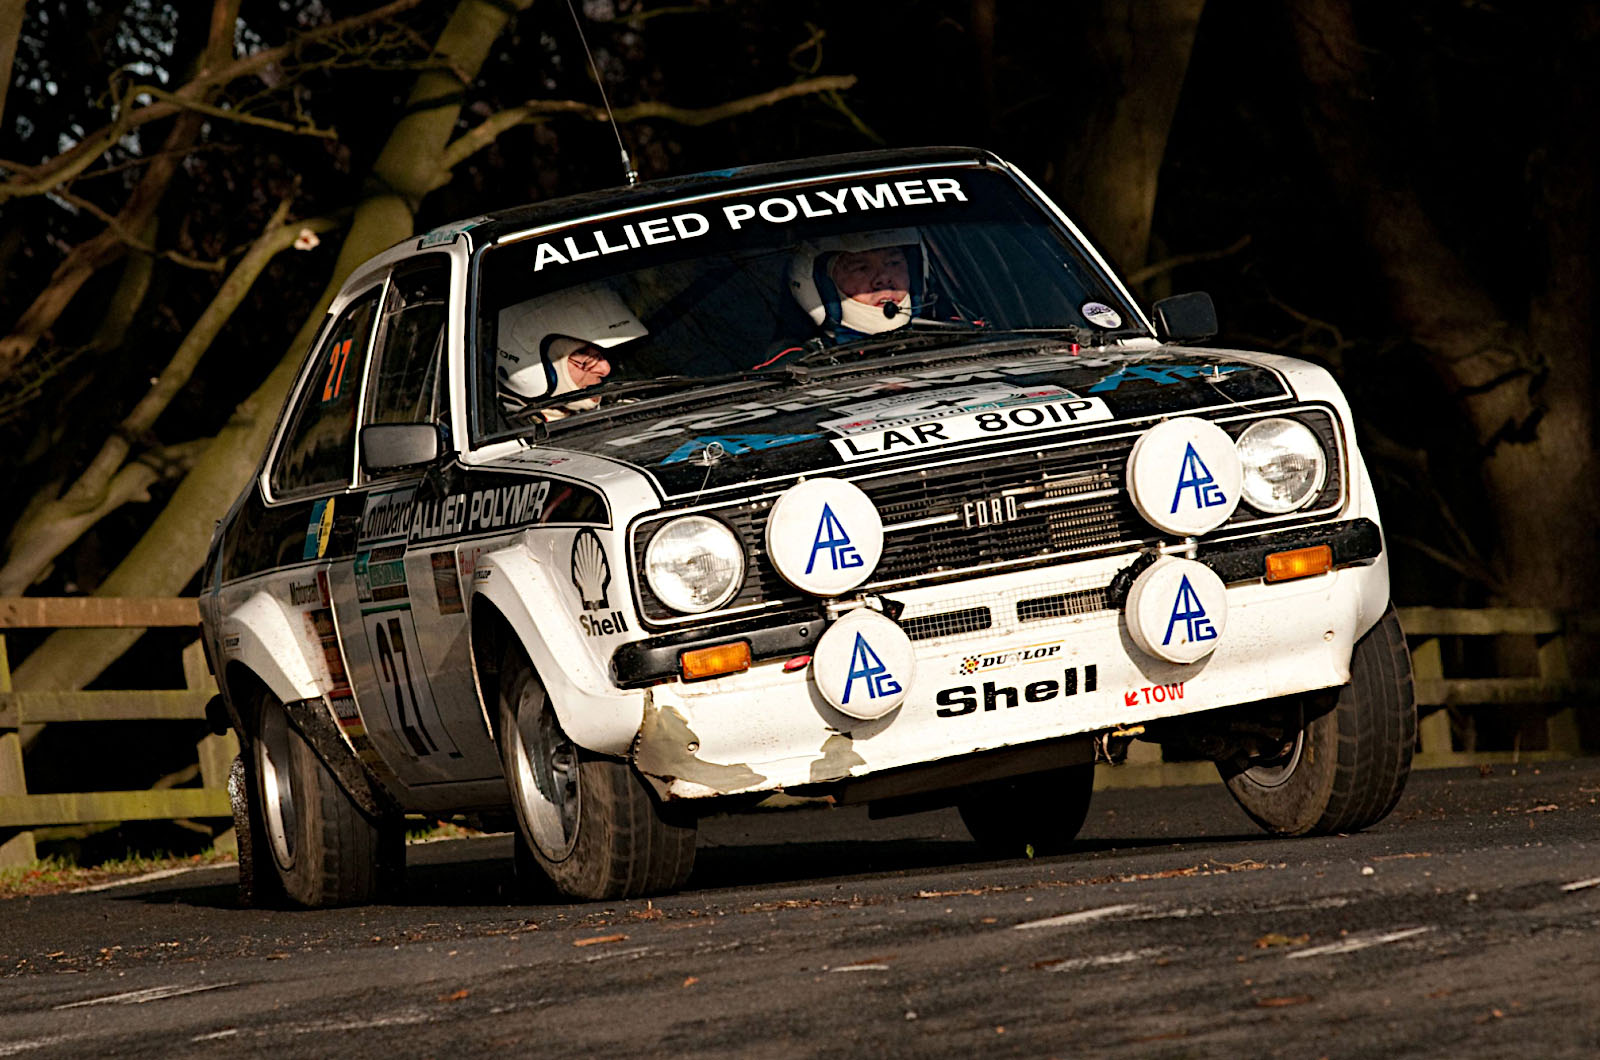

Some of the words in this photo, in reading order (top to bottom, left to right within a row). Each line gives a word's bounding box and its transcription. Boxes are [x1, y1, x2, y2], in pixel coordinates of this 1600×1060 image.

[533, 212, 710, 272] ALLIED
[723, 177, 969, 231] POLYMER
[843, 422, 951, 456] LAR
[975, 400, 1093, 432] 801P
[409, 494, 467, 541] ALLIED
[468, 481, 551, 530] POLYMER
[963, 496, 1018, 529] FORD
[579, 611, 629, 637] Shell
[981, 645, 1061, 668] DULOP
[376, 617, 439, 756] 27
[936, 664, 1097, 718] Shell
[1140, 682, 1185, 705] TOW
